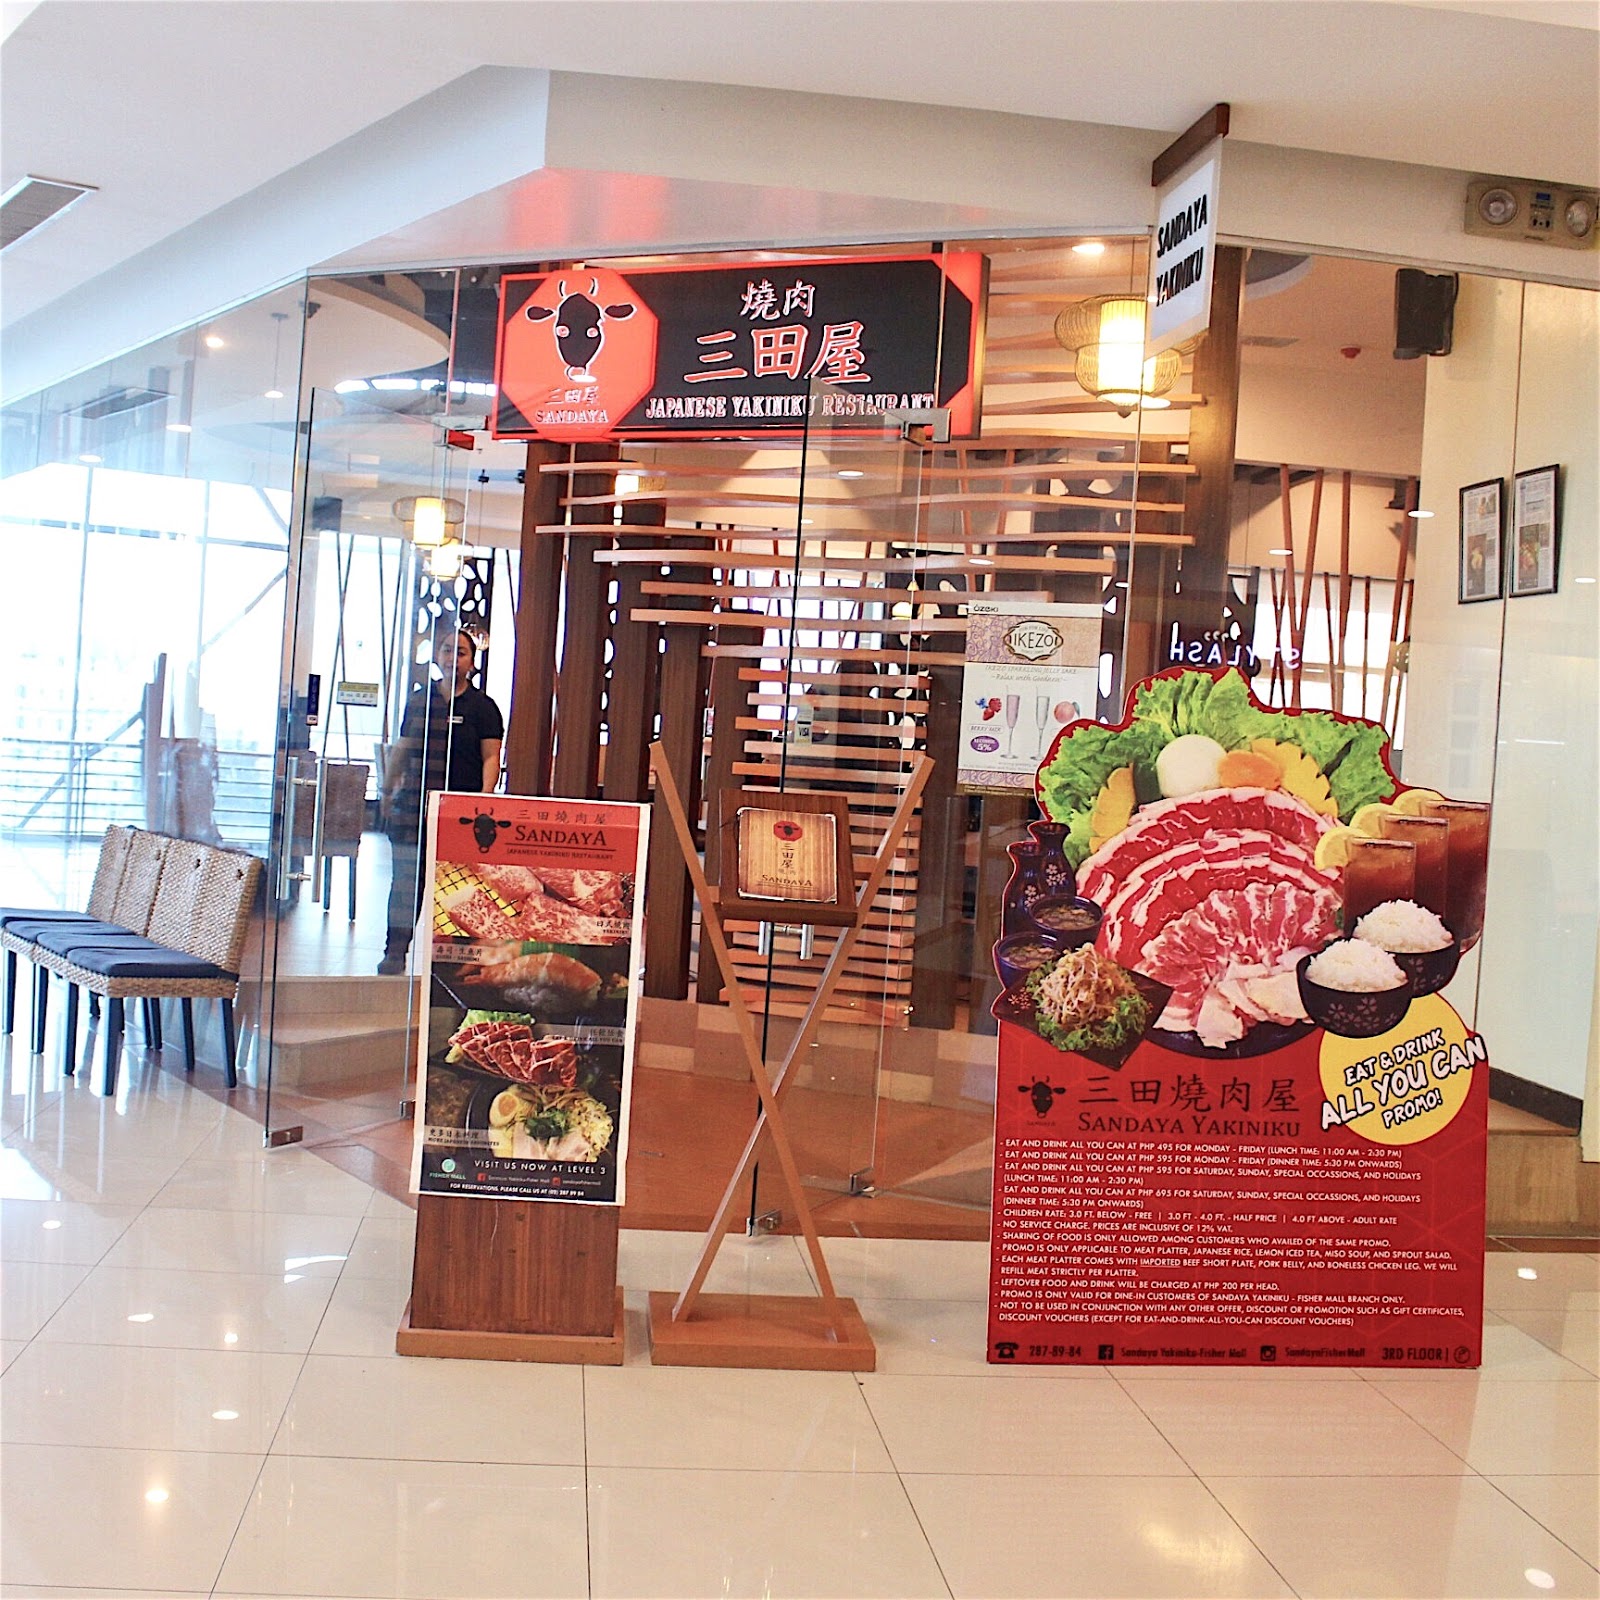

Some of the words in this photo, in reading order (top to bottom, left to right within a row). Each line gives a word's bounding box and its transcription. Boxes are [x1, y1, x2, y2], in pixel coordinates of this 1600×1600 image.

[1157, 194, 1207, 258] SANDAYA
[1156, 247, 1204, 307] YAKINIKU
[683, 320, 871, 385] 三田屋
[646, 396, 727, 418] JAPANESE
[731, 395, 816, 418] YAKINIKU
[822, 393, 935, 416] RESTAURANT
[536, 409, 609, 424] SANDAYA
[1013, 631, 1054, 649] IKEZO
[515, 825, 607, 846] SANDAYA
[762, 874, 813, 887] SANDAYA
[1344, 1057, 1377, 1086] EAT
[1379, 1051, 1394, 1070] &
[1393, 1027, 1445, 1064] DRINK
[1321, 1087, 1375, 1130] ALL
[1372, 1061, 1428, 1105] YOU
[1431, 1035, 1488, 1080] CAN
[1382, 1088, 1443, 1129] PROMO!
[1078, 1112, 1185, 1134] SANDAYA
[1191, 1115, 1300, 1137] YAKINIKU
[1021, 1139, 1041, 1147] AND
[1086, 1141, 1104, 1149] YOU
[1106, 1141, 1125, 1149] CAN
[1139, 1142, 1155, 1150] PHP
[1156, 1143, 1173, 1151] 495
[1175, 1143, 1192, 1151] FOR
[1193, 1144, 1230, 1152] MONDAY
[1238, 1145, 1266, 1153] FRIDAY
[1267, 1146, 1298, 1154] (LUNCH
[1387, 1149, 1402, 1158] PM)
[474, 1159, 500, 1168] VISIT
[504, 1162, 517, 1170] US
[521, 1163, 547, 1171] NOW
[551, 1164, 563, 1172] AT
[567, 1165, 595, 1174] LEVEL
[600, 1167, 606, 1175] 3
[1003, 1208, 1043, 1216] CHILDREN
[1068, 1210, 1082, 1218] 3.0
[1134, 1211, 1152, 1219] FREE
[1167, 1212, 1181, 1220] 3.0
[1182, 1212, 1192, 1220] FT
[1199, 1213, 1213, 1221] 4.0
[1254, 1214, 1277, 1222] PRICE
[1317, 1215, 1344, 1223] ABOVE
[1352, 1216, 1377, 1224] ADULT
[1002, 1232, 1040, 1240] SHARING
[1042, 1232, 1054, 1240] OF
[1056, 1233, 1082, 1241] FOOD
[1083, 1233, 1092, 1241] IS
[1118, 1234, 1159, 1242] ALLOWED
[1160, 1235, 1194, 1243] AMONG
[1196, 1236, 1245, 1244] CUSTOMERS
[1246, 1237, 1270, 1245] WHO
[1304, 1238, 1316, 1246] OF
[1318, 1238, 1333, 1246] THE
[1335, 1238, 1356, 1246] SAME
[1001, 1255, 1024, 1263] EACH
[1025, 1255, 1048, 1263] MEAT
[1049, 1256, 1082, 1264] PLATTER
[1083, 1256, 1114, 1264] COMES
[1115, 1257, 1138, 1265] WITH
[1139, 1258, 1181, 1267] IMPORTED
[1182, 1258, 1200, 1266] BEEF
[1327, 1261, 1366, 1269] BONELESS
[998, 1313, 1042, 1321] DISCOUNT
[1044, 1314, 1089, 1322] VOUCHERS
[1091, 1314, 1122, 1323] (EXCEPT
[1143, 1315, 1263, 1324] EAT-AND-DRINK-ALL-YOU-CAN
[1308, 1317, 1354, 1325] VOUCHERS)
[1382, 1346, 1404, 1360] 3RD
[1407, 1347, 1443, 1361] FLOOR
